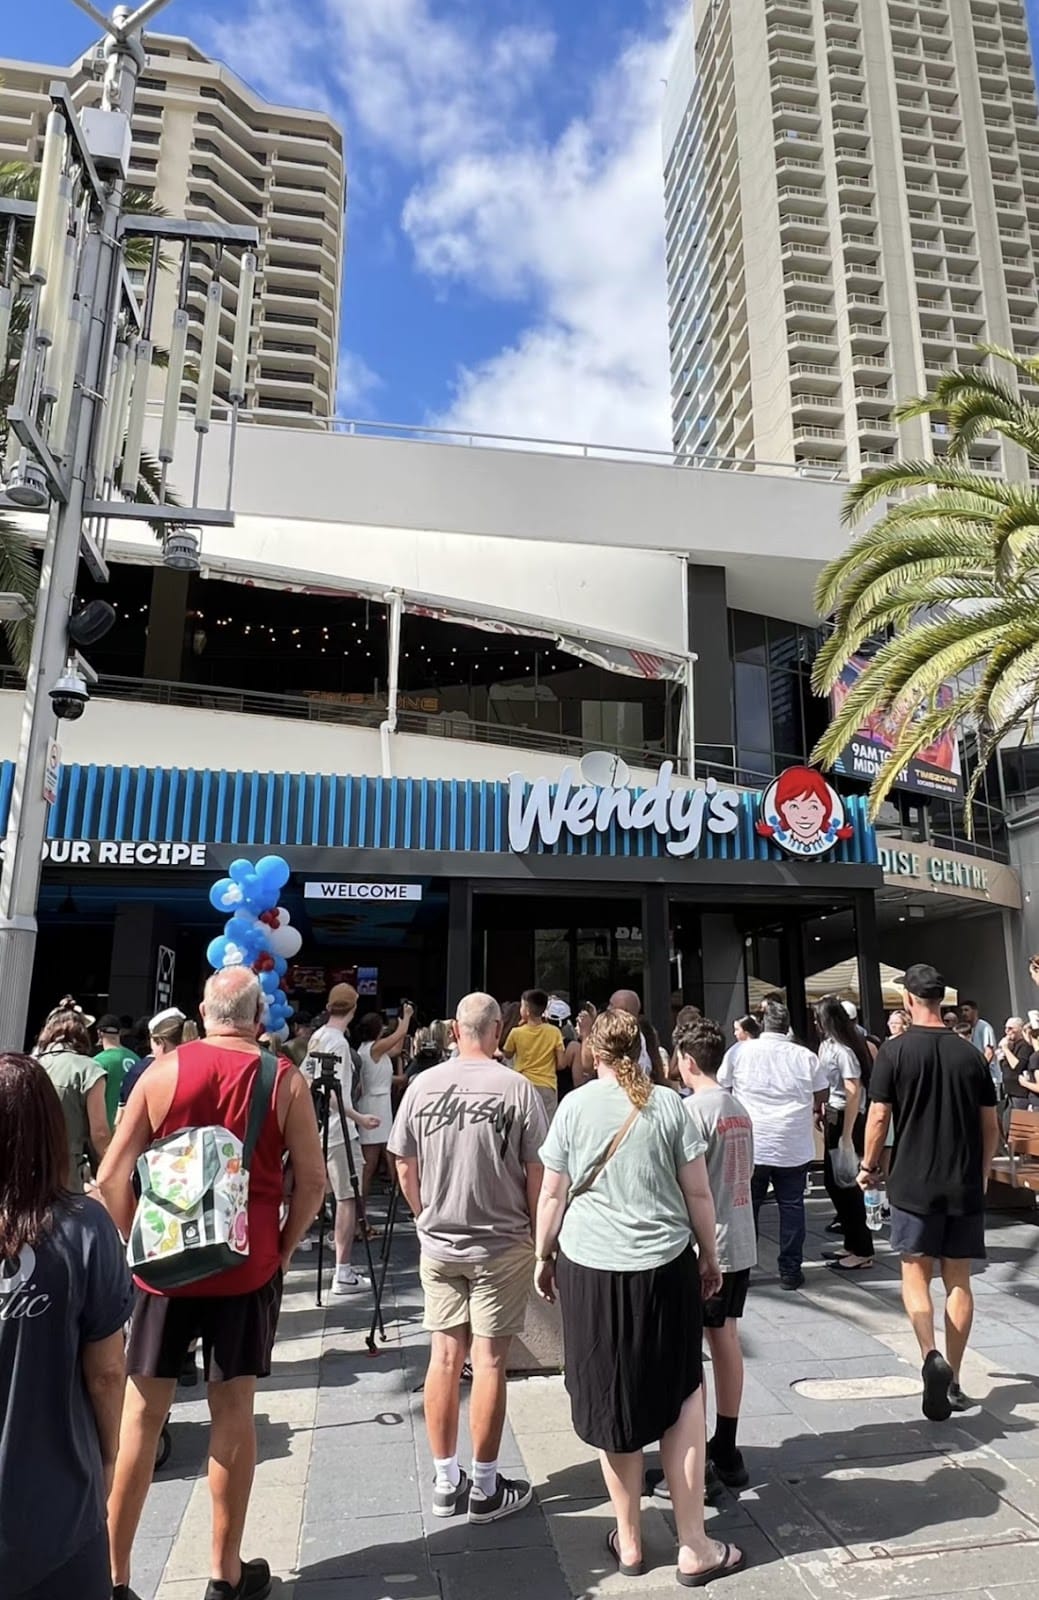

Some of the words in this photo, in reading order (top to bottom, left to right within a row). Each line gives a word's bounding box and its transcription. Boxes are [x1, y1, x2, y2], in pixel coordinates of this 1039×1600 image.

[851, 743, 878, 760] 9AM
[507, 759, 740, 857] Wendy's
[98, 842, 207, 866] RECIPE
[929, 857, 989, 889] CENTRE
[320, 884, 408, 898] WELCOME
